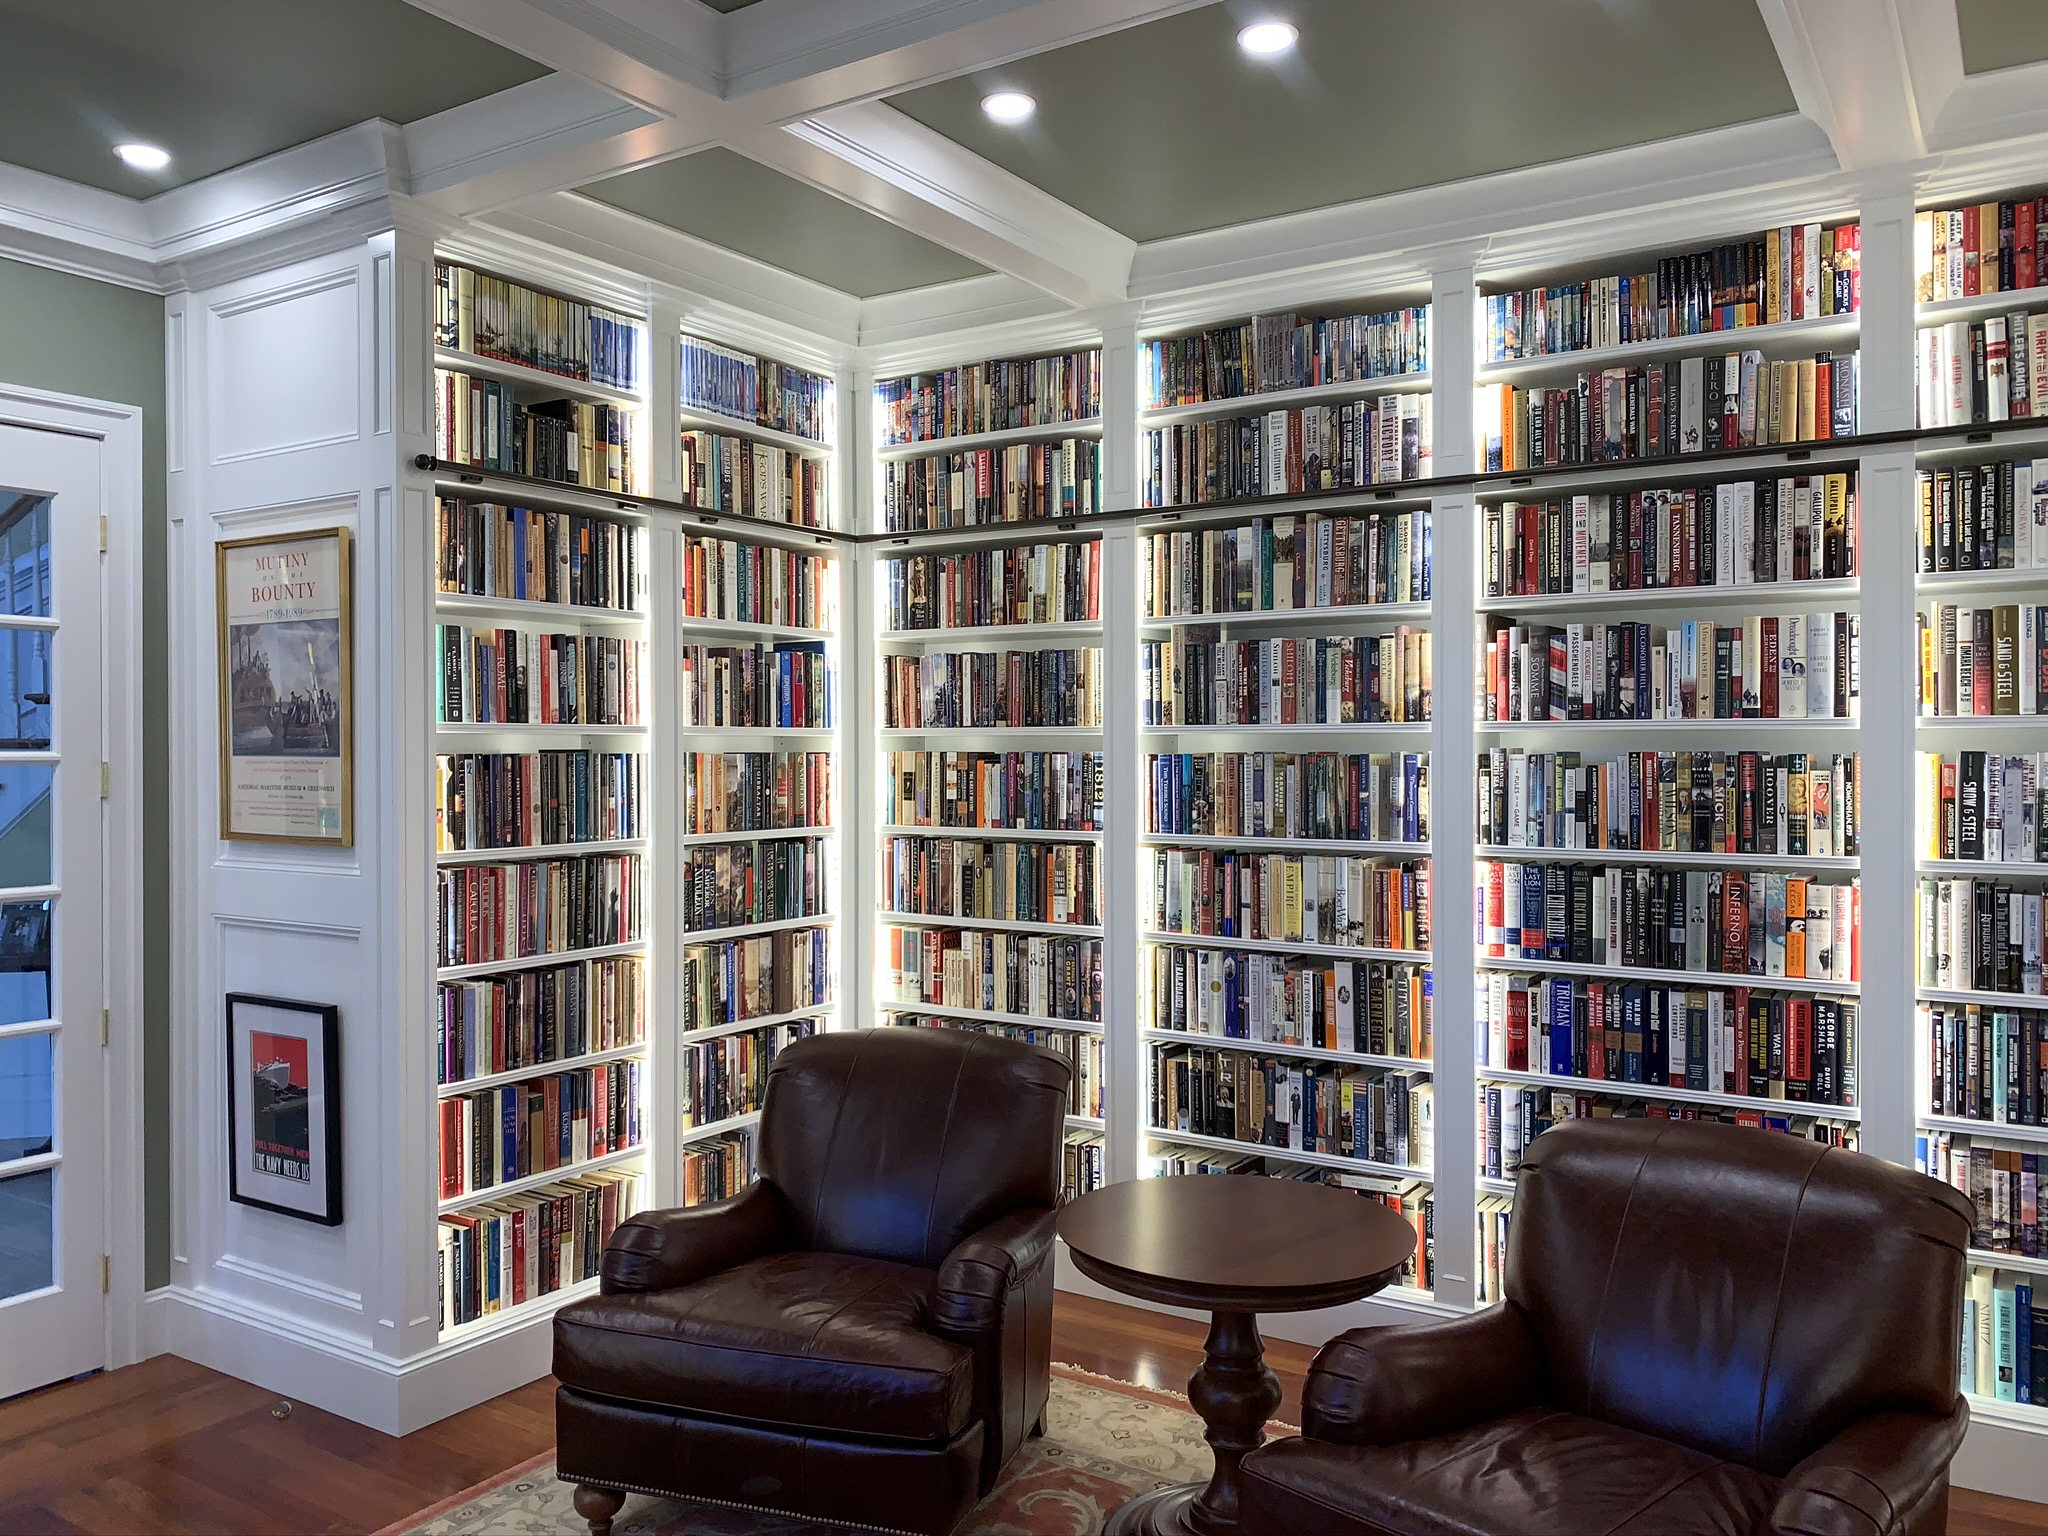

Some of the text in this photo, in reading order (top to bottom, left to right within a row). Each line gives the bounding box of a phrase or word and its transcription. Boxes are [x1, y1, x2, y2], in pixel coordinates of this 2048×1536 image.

[2014, 315, 2025, 398] HITLER'S ARMIES
[2035, 331, 2046, 360] ARMY
[1709, 361, 1720, 401] HERO
[1840, 360, 1850, 407] MONASH
[1382, 418, 1393, 462] VICTORY
[1575, 502, 1586, 518] FIRE
[1812, 492, 1823, 525] GALLIPOLI
[1829, 480, 1839, 514] GALLIPOLI
[1615, 499, 1623, 551] KAISER'S ARMY
[1722, 496, 1731, 574] GERMANY ASCENDANT
[2018, 501, 2026, 543] NORWAY
[256, 552, 309, 571] MUTINY
[1334, 520, 1347, 573] GETTYSBURG
[1575, 530, 1586, 568] MOVEMENT
[252, 582, 316, 602] BOUNTY
[1639, 626, 1646, 635] TO
[1789, 618, 1800, 655] Dreadnought
[1945, 609, 1954, 655] OVERLORD
[1997, 637, 2012, 660] SAND
[496, 657, 506, 691] ROME
[1328, 653, 1338, 686] Vicksburg
[1342, 659, 1353, 693] Vicksburg
[1530, 658, 1540, 698] SOMME
[1571, 632, 1579, 688] PASSCHENDAELE
[1960, 646, 1971, 687] OMAHA BEACH
[1997, 671, 2012, 699] STEEL
[1094, 764, 1104, 800] 1812
[1630, 758, 1639, 816] ENDURING COURAGE
[1766, 768, 1774, 824] HOOVER
[1962, 782, 1977, 806] SNOW
[1989, 757, 2000, 818] NO SILENT NIGHT
[1665, 789, 1677, 836] WILSON
[1715, 787, 1724, 822] MICK
[1962, 817, 1976, 842] STEEL
[469, 882, 478, 932] CALIGULA
[1286, 866, 1294, 909] EMPIRE
[1573, 887, 1586, 932] CHURCHILL
[1729, 887, 1741, 942] INFERNO
[1639, 928, 1644, 936] AT
[1981, 914, 1992, 965] RETRIBUTION
[1371, 988, 1383, 1043] CARNEGIE
[1397, 978, 1408, 1020] TITAN
[1530, 992, 1538, 1013] Japan's
[1556, 984, 1570, 1026] TRUMAN
[1773, 1034, 1781, 1055] WAR
[1818, 1006, 1826, 1054] MARSHALL
[1969, 1015, 1977, 1076] BIG GUN BATTLES
[1824, 1090, 1830, 1098] L.
[256, 1153, 310, 1180] THE NAVY NEEDS US
[1981, 1304, 1990, 1345] NIMITZ
